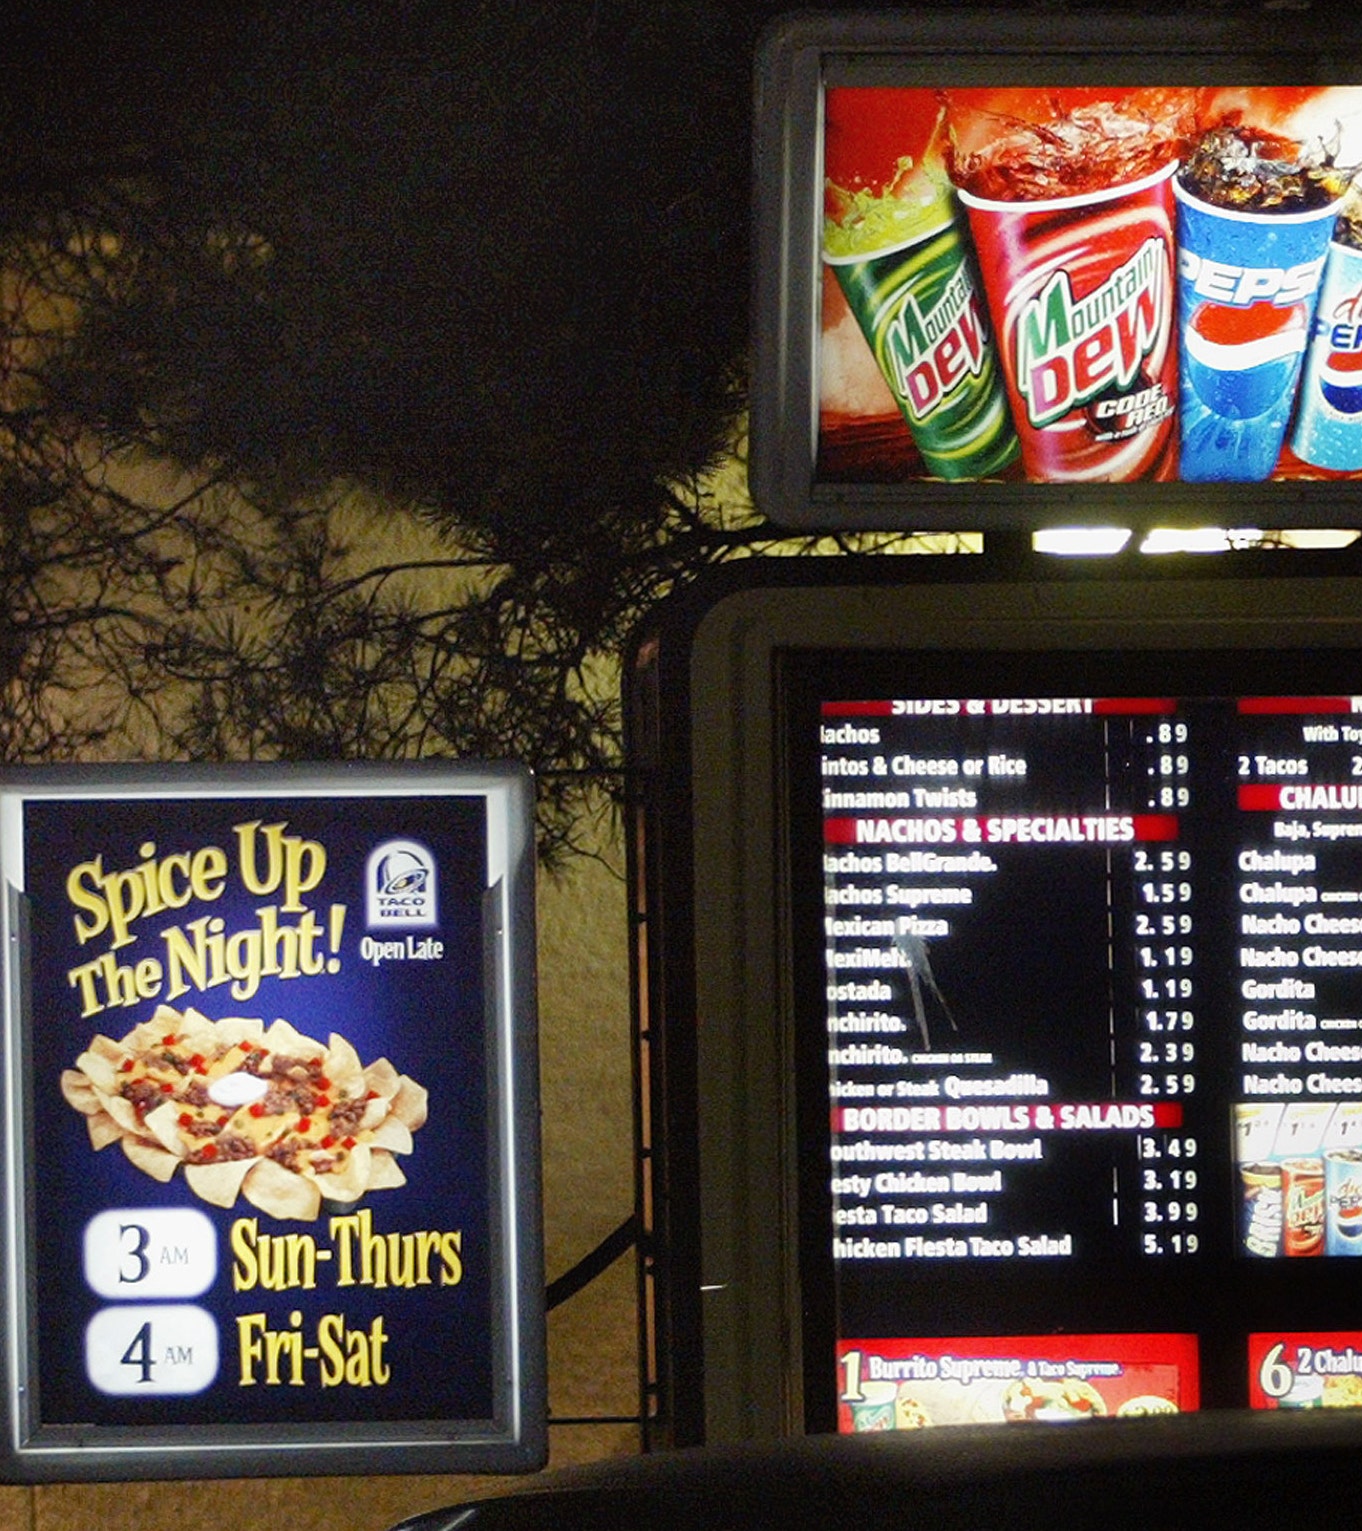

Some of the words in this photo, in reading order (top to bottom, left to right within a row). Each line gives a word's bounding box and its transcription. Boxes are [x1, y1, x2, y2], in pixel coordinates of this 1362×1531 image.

[1178, 248, 1328, 303] PEPS
[1022, 240, 1163, 360] Mountain
[1096, 383, 1163, 418] CODE
[1146, 723, 1188, 744] .89
[1303, 726, 1339, 742] With
[821, 757, 868, 776] intos
[892, 757, 958, 776] Cheese
[963, 761, 983, 775] or
[988, 755, 1027, 775] Rice
[1148, 755, 1189, 776] .89
[1238, 756, 1250, 775] 2
[1255, 755, 1309, 775] Tacos
[822, 789, 910, 809] innamon
[913, 789, 977, 809] Twists
[1148, 788, 1190, 808] .89
[856, 819, 957, 843] NACHOS
[962, 819, 982, 842] &
[987, 817, 1135, 842] SPECIALTIES
[1134, 851, 1191, 872] 2.59
[1238, 851, 1316, 873] Chalupa
[66, 841, 228, 952] Spice
[232, 820, 328, 913] Up
[1143, 883, 1192, 903] 1.59
[377, 897, 425, 907] TACO
[380, 909, 428, 918] BELL
[1240, 914, 1301, 935] Nacho
[1135, 916, 1193, 936] 2.59
[68, 957, 162, 1019] The
[160, 904, 347, 1002] Night!
[360, 937, 405, 966] Open
[407, 935, 443, 960] Late
[826, 982, 892, 1001] ostada
[1142, 979, 1193, 998] 1.19
[1241, 979, 1316, 1000] Gordita
[1146, 1012, 1194, 1030] 1.79
[1242, 1042, 1301, 1063] Nacho
[843, 1108, 940, 1131] BORDER
[945, 1107, 1030, 1129] BOWLS
[1035, 1107, 1055, 1128] &
[1061, 1105, 1155, 1128] SALADS
[831, 1141, 926, 1161] outhwest
[929, 1141, 986, 1160] Steak
[990, 1139, 1043, 1160] Bowl
[1143, 1171, 1198, 1190] 3.19
[881, 1204, 929, 1224] Taco
[931, 1203, 988, 1223] Salad
[1144, 1202, 1199, 1221] 3.99
[118, 1224, 150, 1284] 3
[160, 1246, 189, 1264] AM
[231, 1209, 463, 1292] Sun-Thurs
[905, 1236, 968, 1257] Fiesta
[970, 1236, 1015, 1257] Taco
[1018, 1235, 1072, 1255] Salad
[1143, 1234, 1199, 1254] 5.19
[120, 1321, 157, 1384] 4
[164, 1346, 193, 1365] AM
[235, 1310, 390, 1388] Fri-Sat
[840, 1351, 865, 1403] 1
[869, 1355, 937, 1380] Burrito
[1260, 1343, 1294, 1398] 6
[1297, 1348, 1313, 1374] 2
